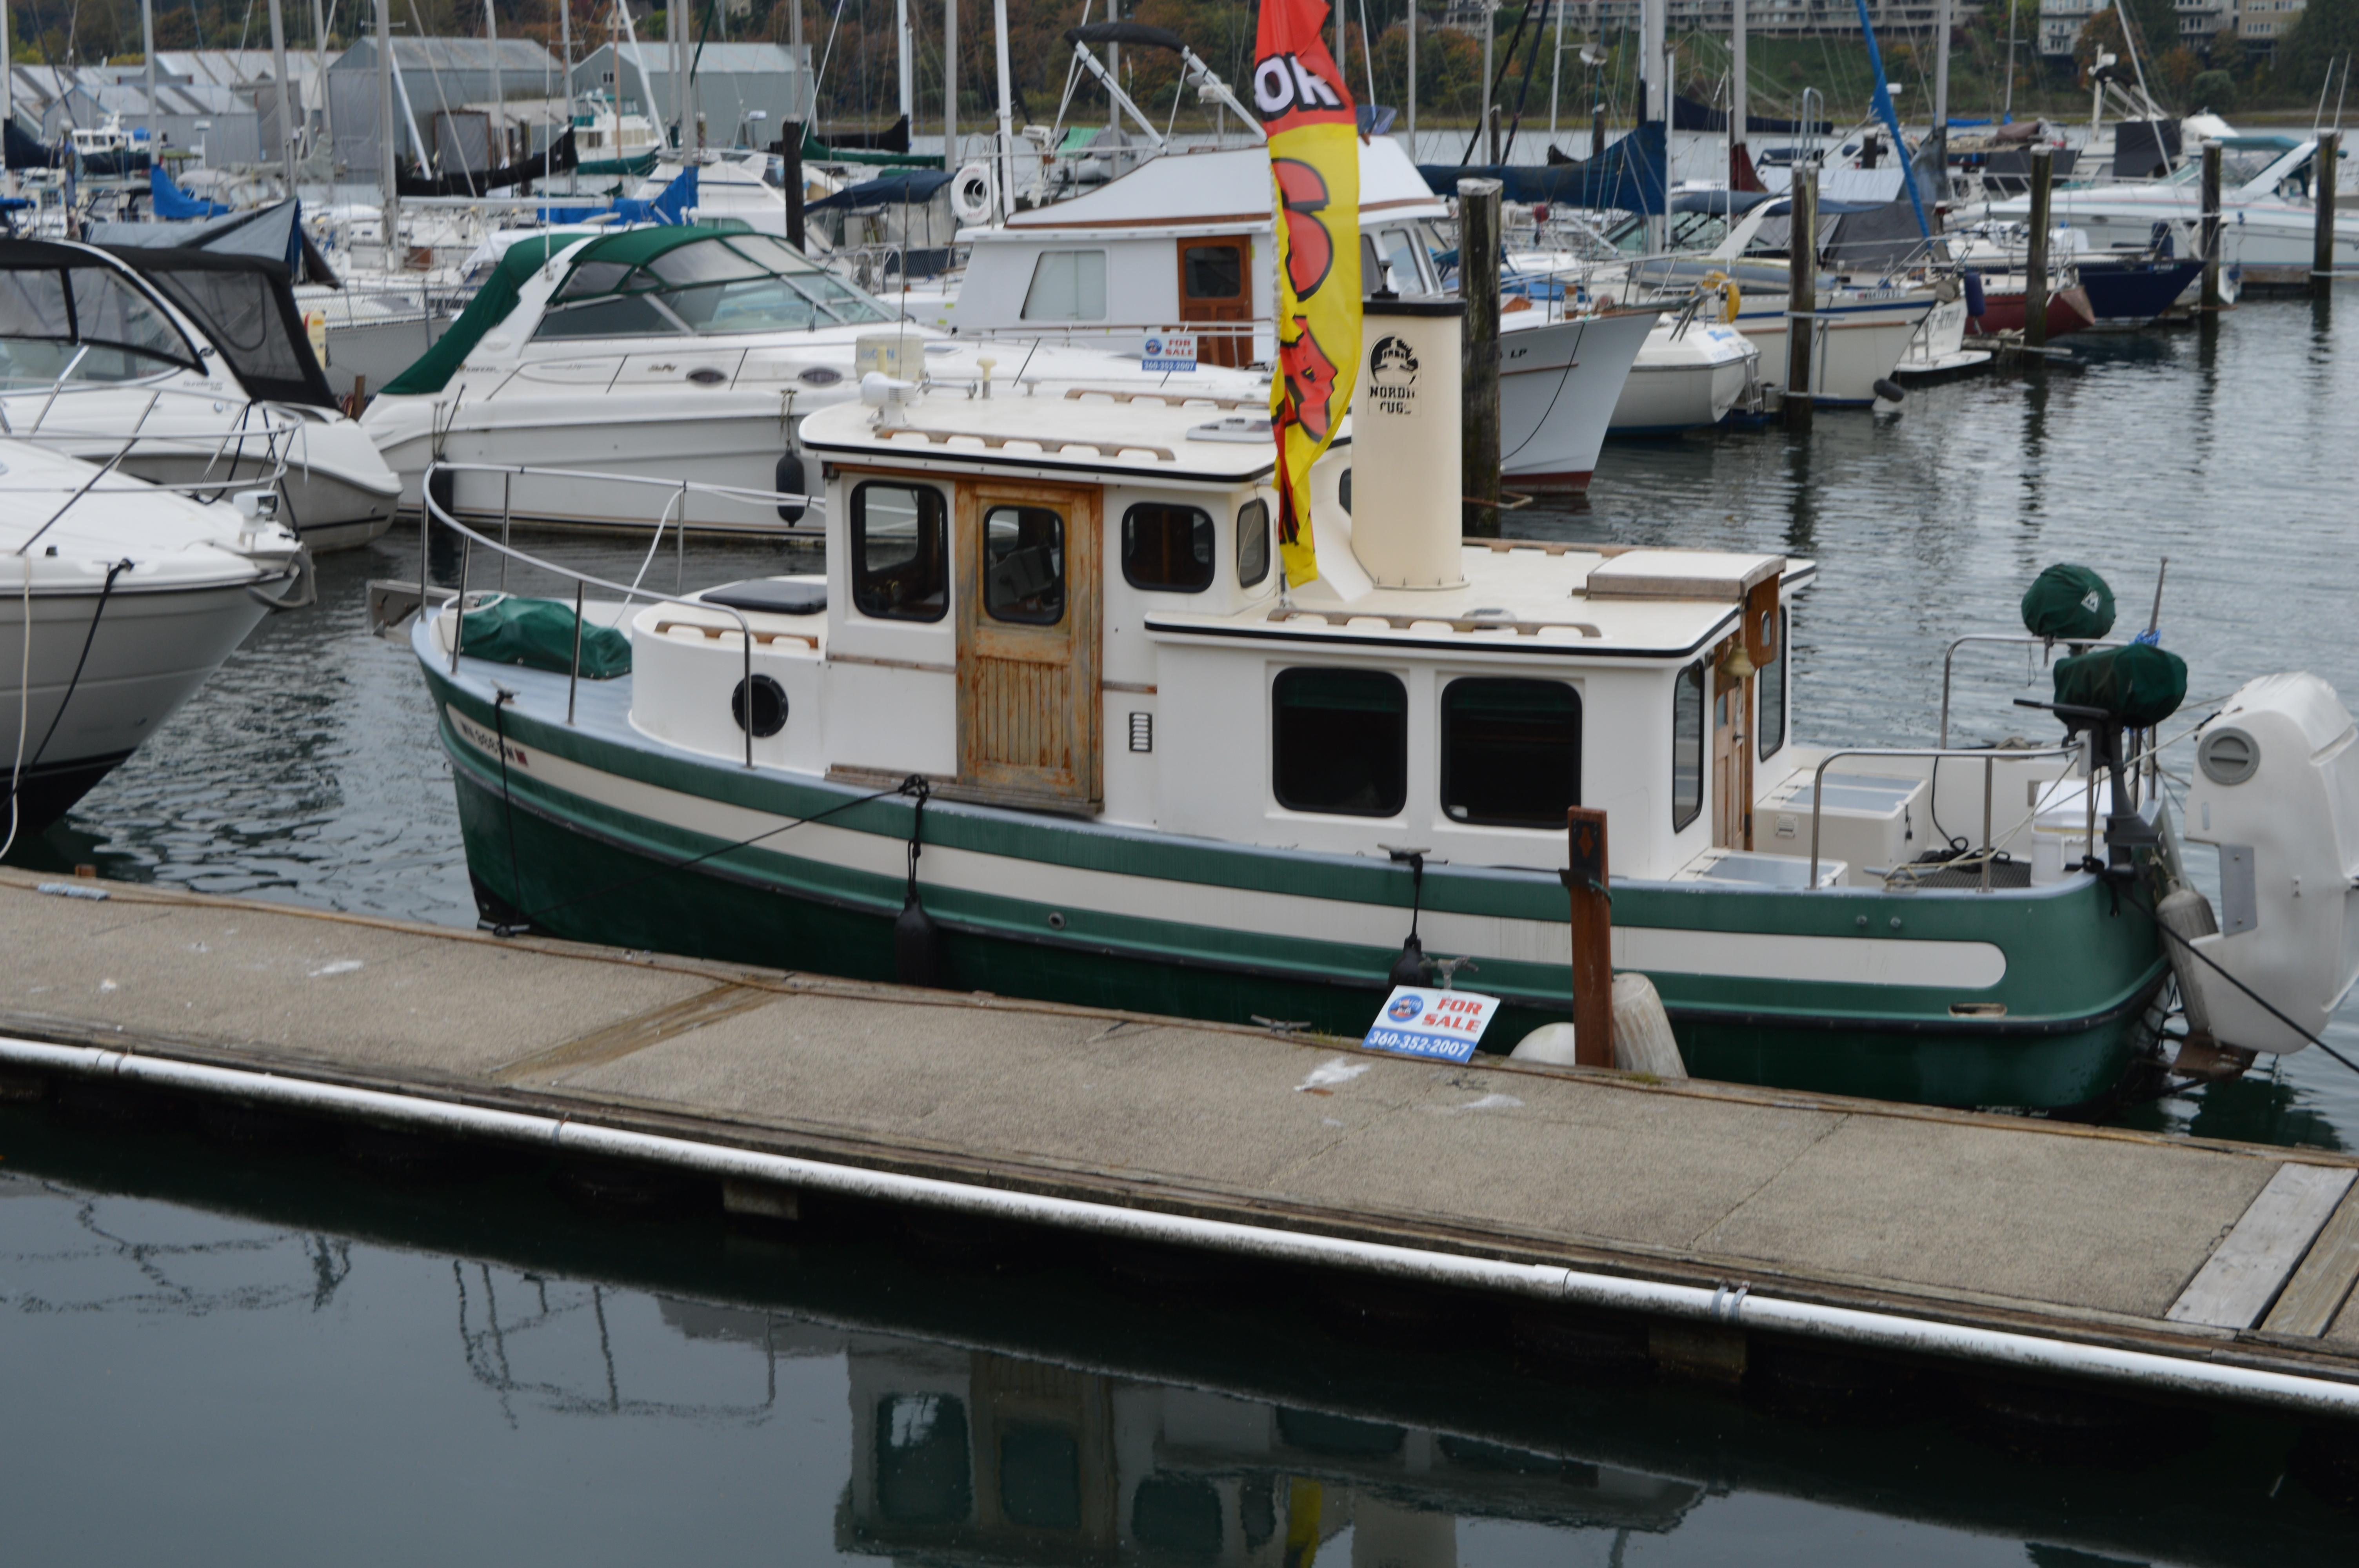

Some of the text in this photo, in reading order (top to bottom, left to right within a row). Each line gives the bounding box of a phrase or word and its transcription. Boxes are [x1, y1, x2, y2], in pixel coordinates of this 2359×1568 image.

[1510, 348, 1527, 359] LP
[1437, 997, 1483, 1015] FOR
[1422, 1013, 1481, 1033] SALE
[1369, 1030, 1470, 1057] 360-352-2007
